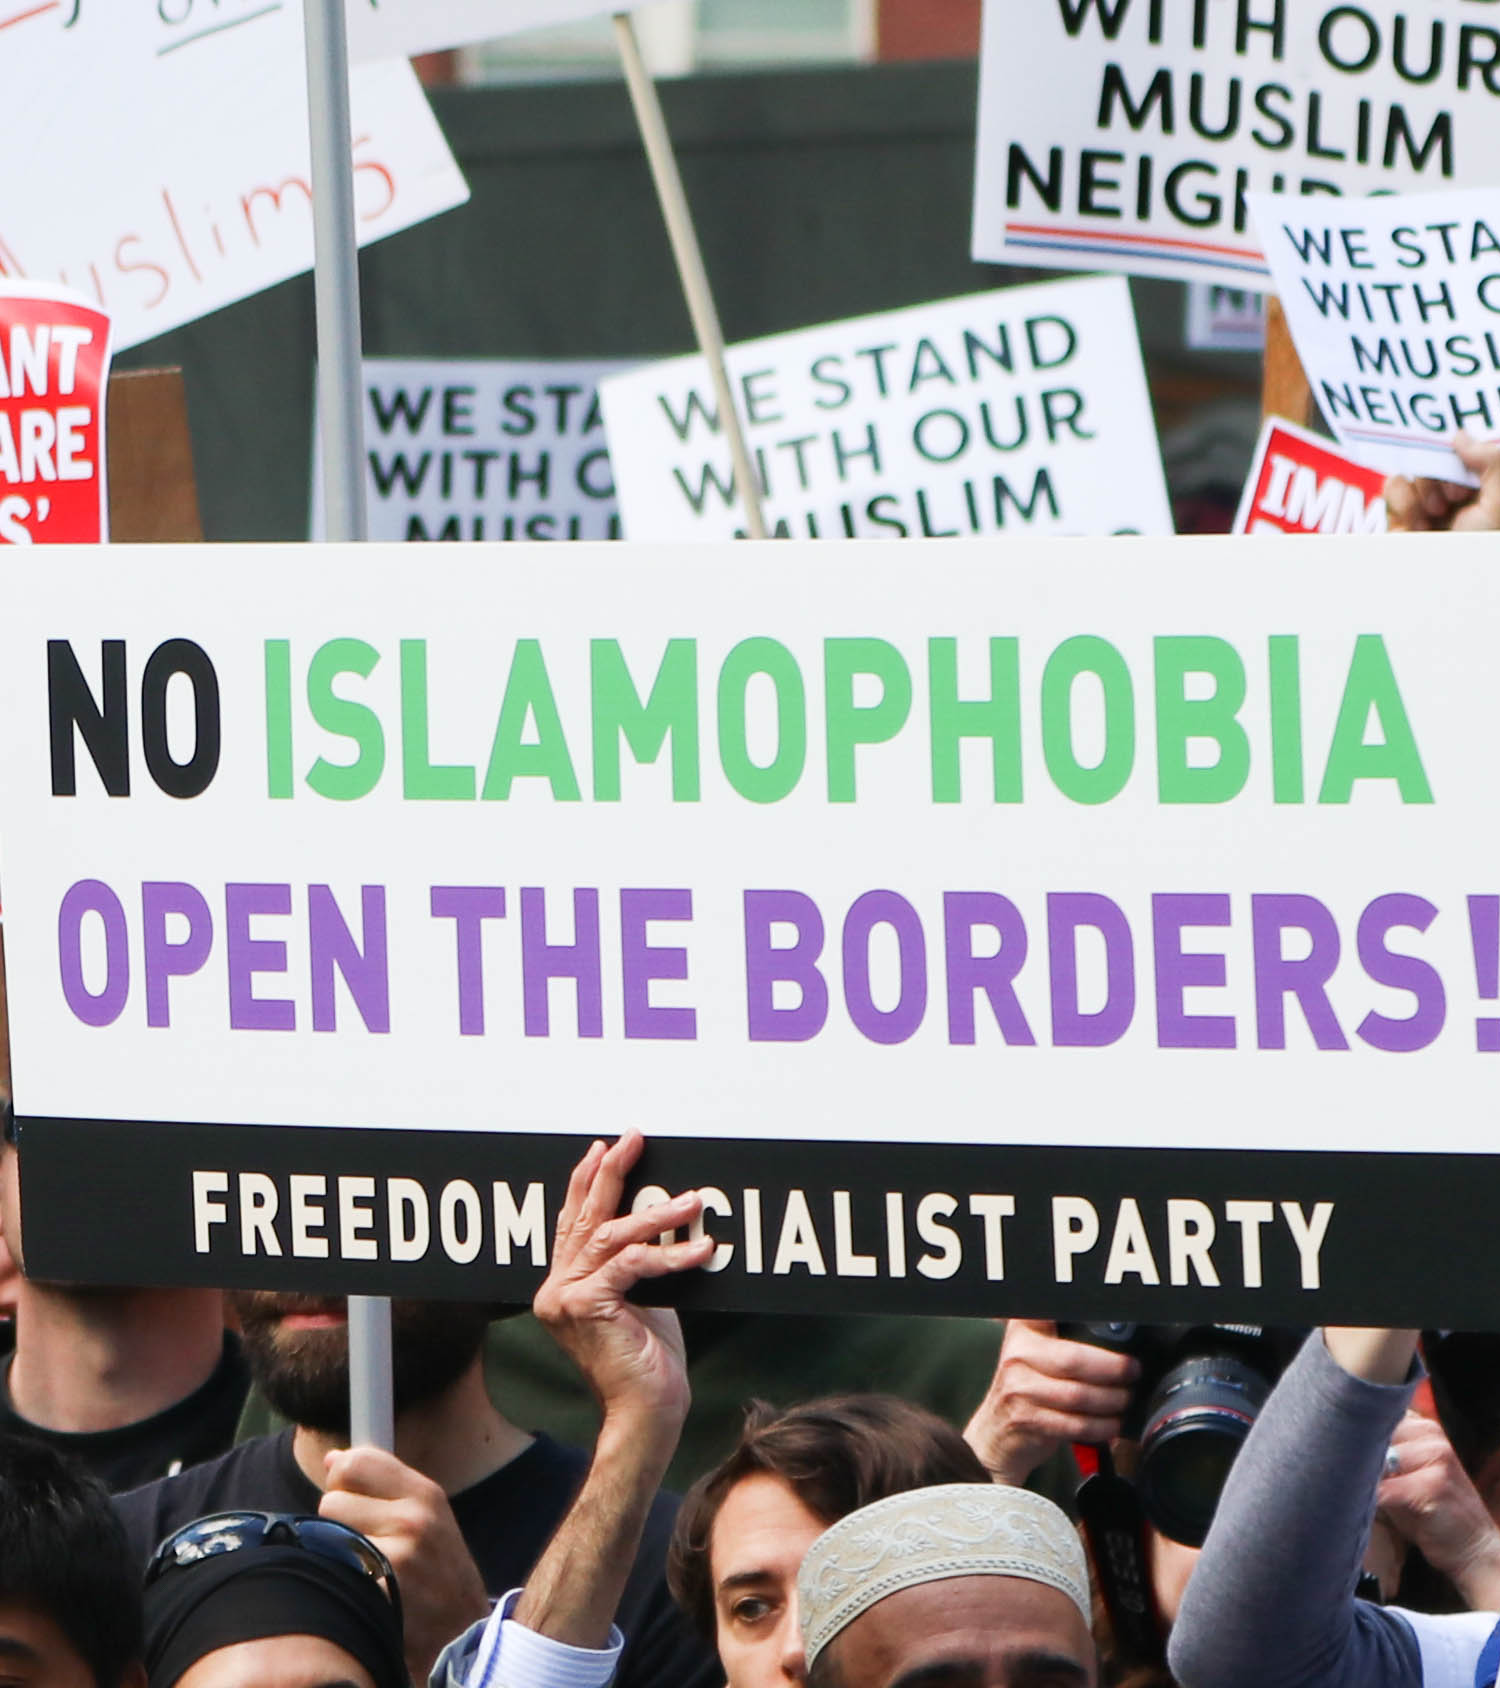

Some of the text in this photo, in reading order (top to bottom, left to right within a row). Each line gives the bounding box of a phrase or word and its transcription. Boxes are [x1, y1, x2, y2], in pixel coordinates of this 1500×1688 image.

[1098, 63, 1455, 178] MUSLIM
[1006, 143, 1398, 232] NEIG
[1283, 224, 1378, 270] WE
[1300, 277, 1457, 325] WITH
[369, 386, 476, 436] WE
[658, 315, 1079, 443] WE STAND
[368, 450, 549, 499] WITH
[673, 423, 883, 516] WITH
[913, 387, 1097, 464] OUR
[49, 636, 222, 799] NO
[264, 632, 1435, 806] ISLAMOPHOBIA
[56, 879, 392, 1035] OPEN
[430, 885, 697, 1042] THE
[191, 1168, 546, 1268] FREEDOM
[1050, 1196, 1335, 1292] PARTY
